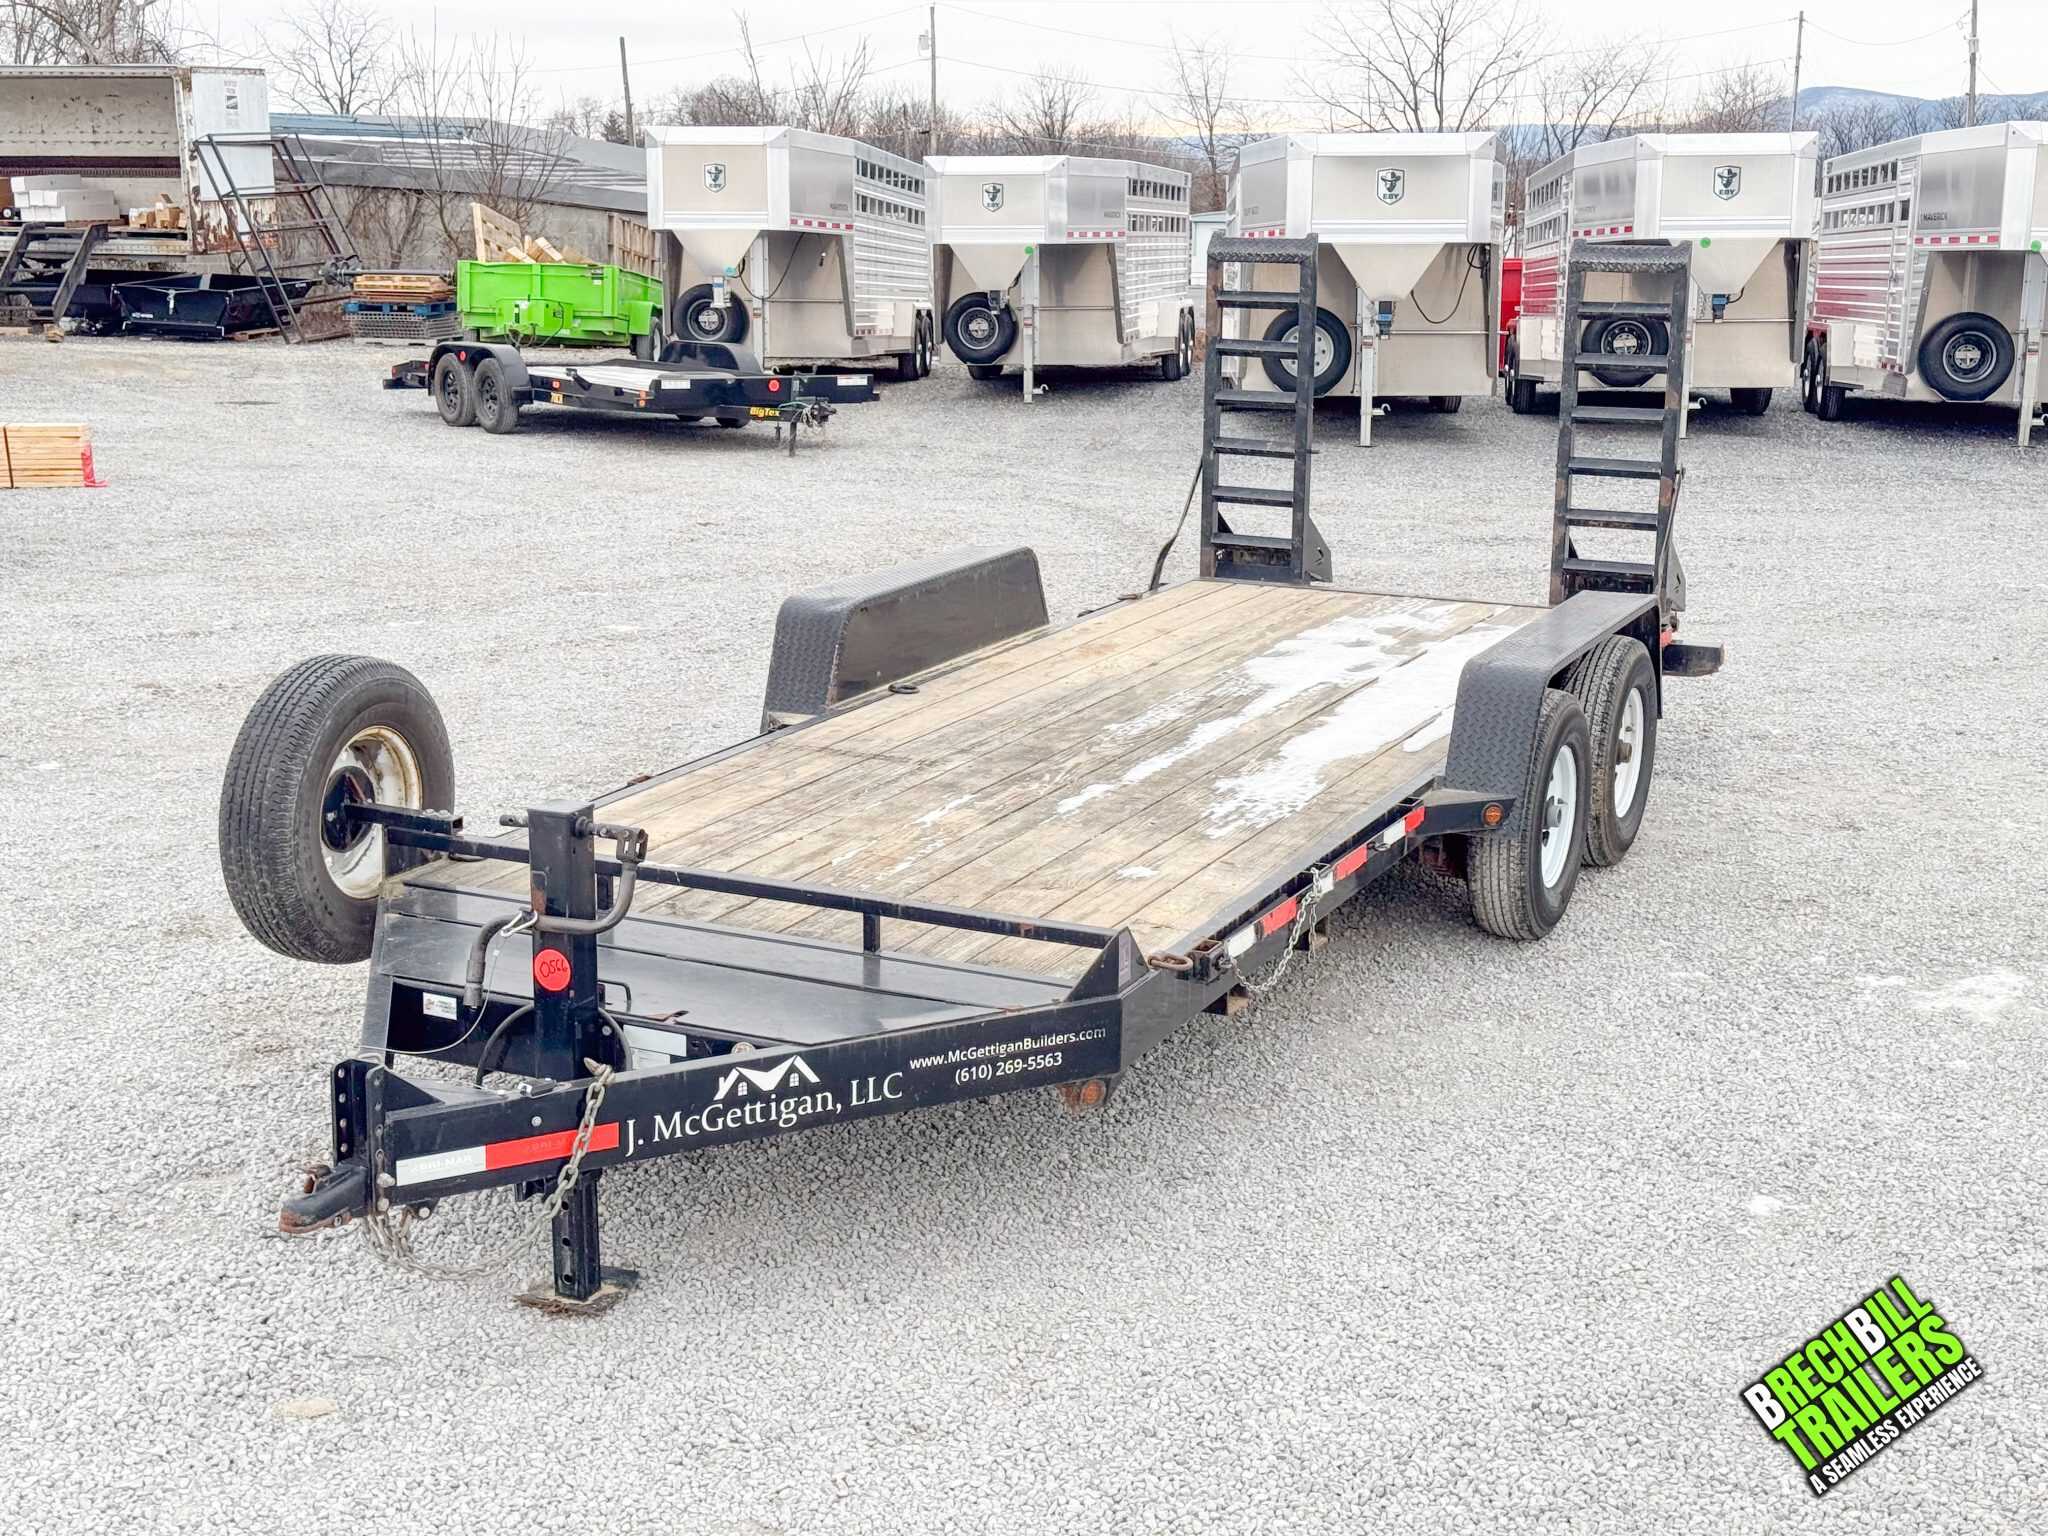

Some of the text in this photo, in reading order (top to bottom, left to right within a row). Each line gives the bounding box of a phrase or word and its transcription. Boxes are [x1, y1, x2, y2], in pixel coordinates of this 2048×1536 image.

[909, 1027, 1106, 1071] www.McGettiganBuilders.com
[955, 1052, 1063, 1086] (610) 269-5563
[624, 1071, 904, 1158] J. McGettigan, LLC
